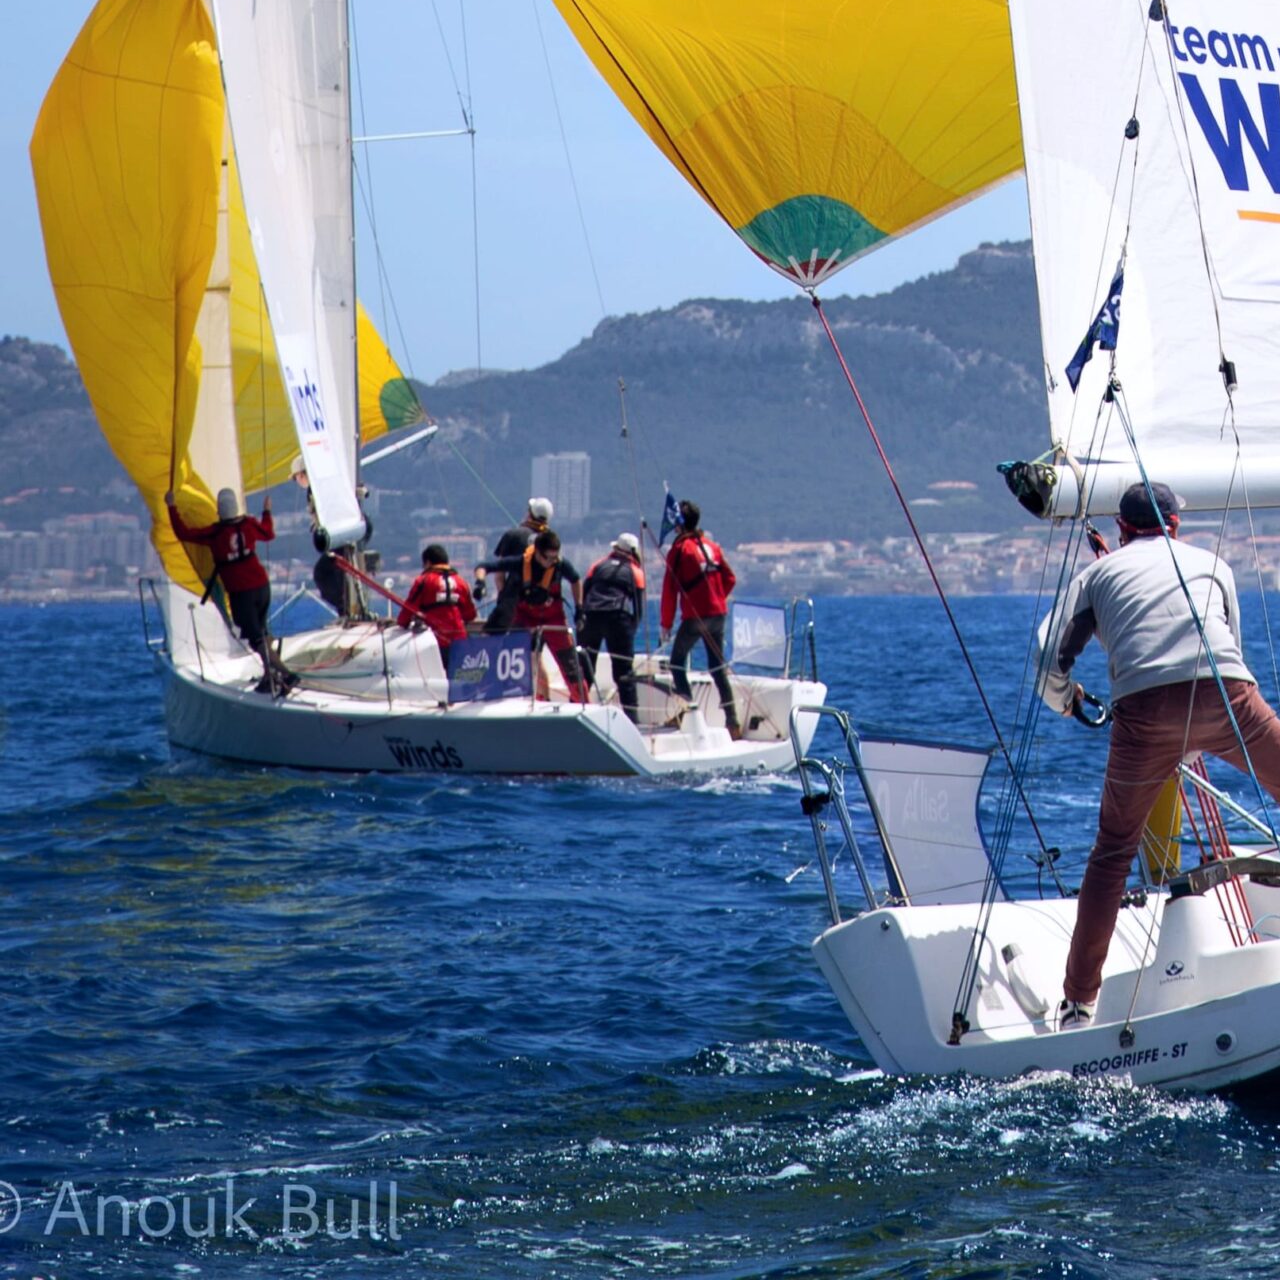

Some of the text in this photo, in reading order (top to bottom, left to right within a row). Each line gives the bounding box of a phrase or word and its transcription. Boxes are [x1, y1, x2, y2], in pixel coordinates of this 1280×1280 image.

[1165, 24, 1276, 72] team
[497, 648, 525, 681] 05
[1072, 1048, 1159, 1078] ESCOGRIFFE
[1171, 1042, 1188, 1059] ST
